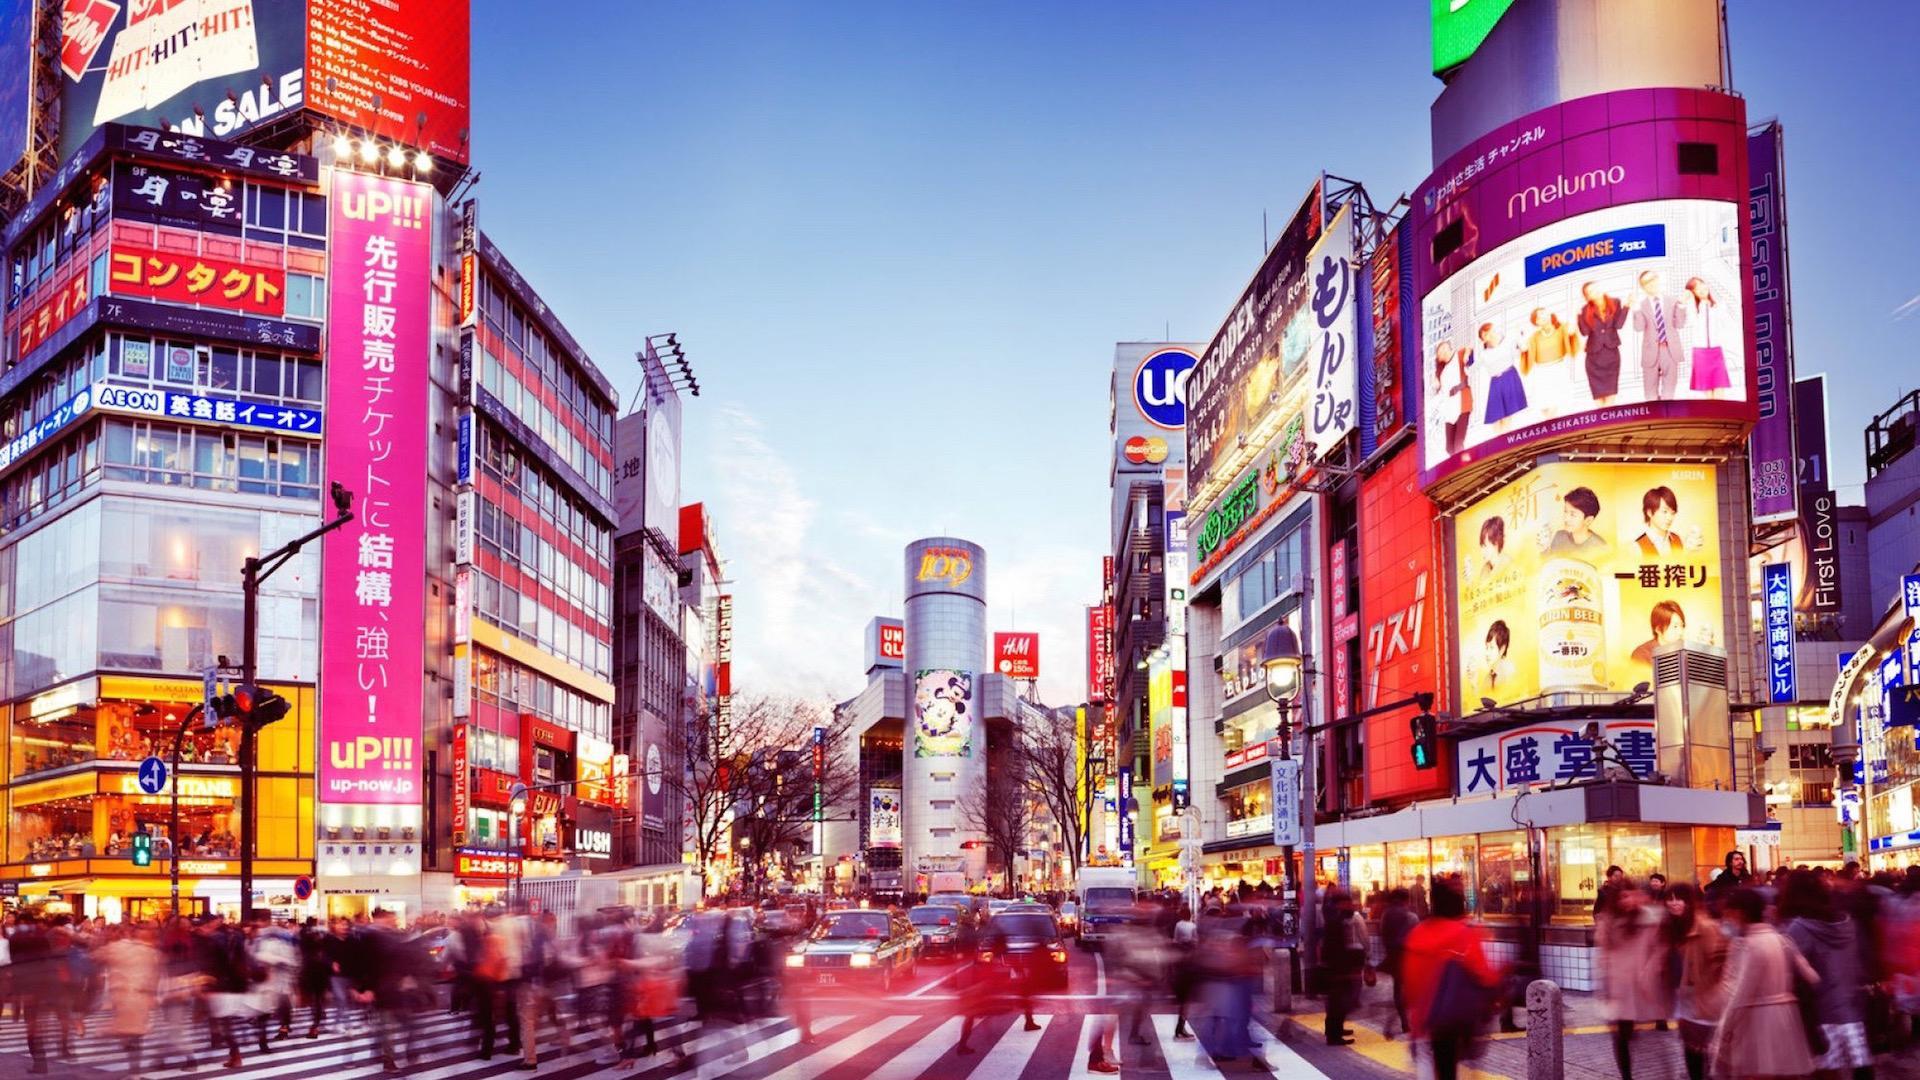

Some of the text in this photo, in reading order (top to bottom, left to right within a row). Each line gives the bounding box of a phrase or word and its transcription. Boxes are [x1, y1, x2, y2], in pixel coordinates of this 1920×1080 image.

[108, 5, 251, 83] HIT! HIT! HIT!
[213, 68, 304, 136] SALE
[409, 81, 434, 99] YOUR
[434, 91, 458, 108] MIND
[224, 147, 299, 177] 月の宴
[1487, 125, 1546, 164] チャンネル
[132, 166, 148, 178] 9F
[132, 176, 235, 219] 月の宴
[341, 190, 421, 229] uP!!!
[1507, 164, 1626, 219] melumo
[1541, 239, 1614, 272] PROMISE
[112, 254, 280, 304] コンタクト
[107, 303, 122, 317] 7F
[1188, 291, 1256, 412] OLDCODEX
[1230, 334, 1264, 380] within
[1264, 304, 1283, 333] the
[1312, 254, 1352, 434] もんじゃ
[1754, 311, 1778, 420] neon
[99, 387, 159, 411] AEON
[170, 393, 317, 431] 英会話イーオン
[1506, 407, 1651, 444] WAKASA SEIKATSU CHANNEL
[1758, 485, 1788, 499] 2468
[1815, 497, 1834, 607] First Love
[916, 553, 974, 589] 109
[1614, 564, 1707, 588] 一番搾り
[883, 643, 904, 657] QL
[1002, 636, 1031, 656] H&M
[1768, 573, 1792, 694] 大盛堂商事ビル
[1091, 609, 1105, 698] Essential
[331, 736, 413, 770] uP!!!
[330, 778, 414, 794] up-now.jp
[575, 828, 612, 852] LUSH
